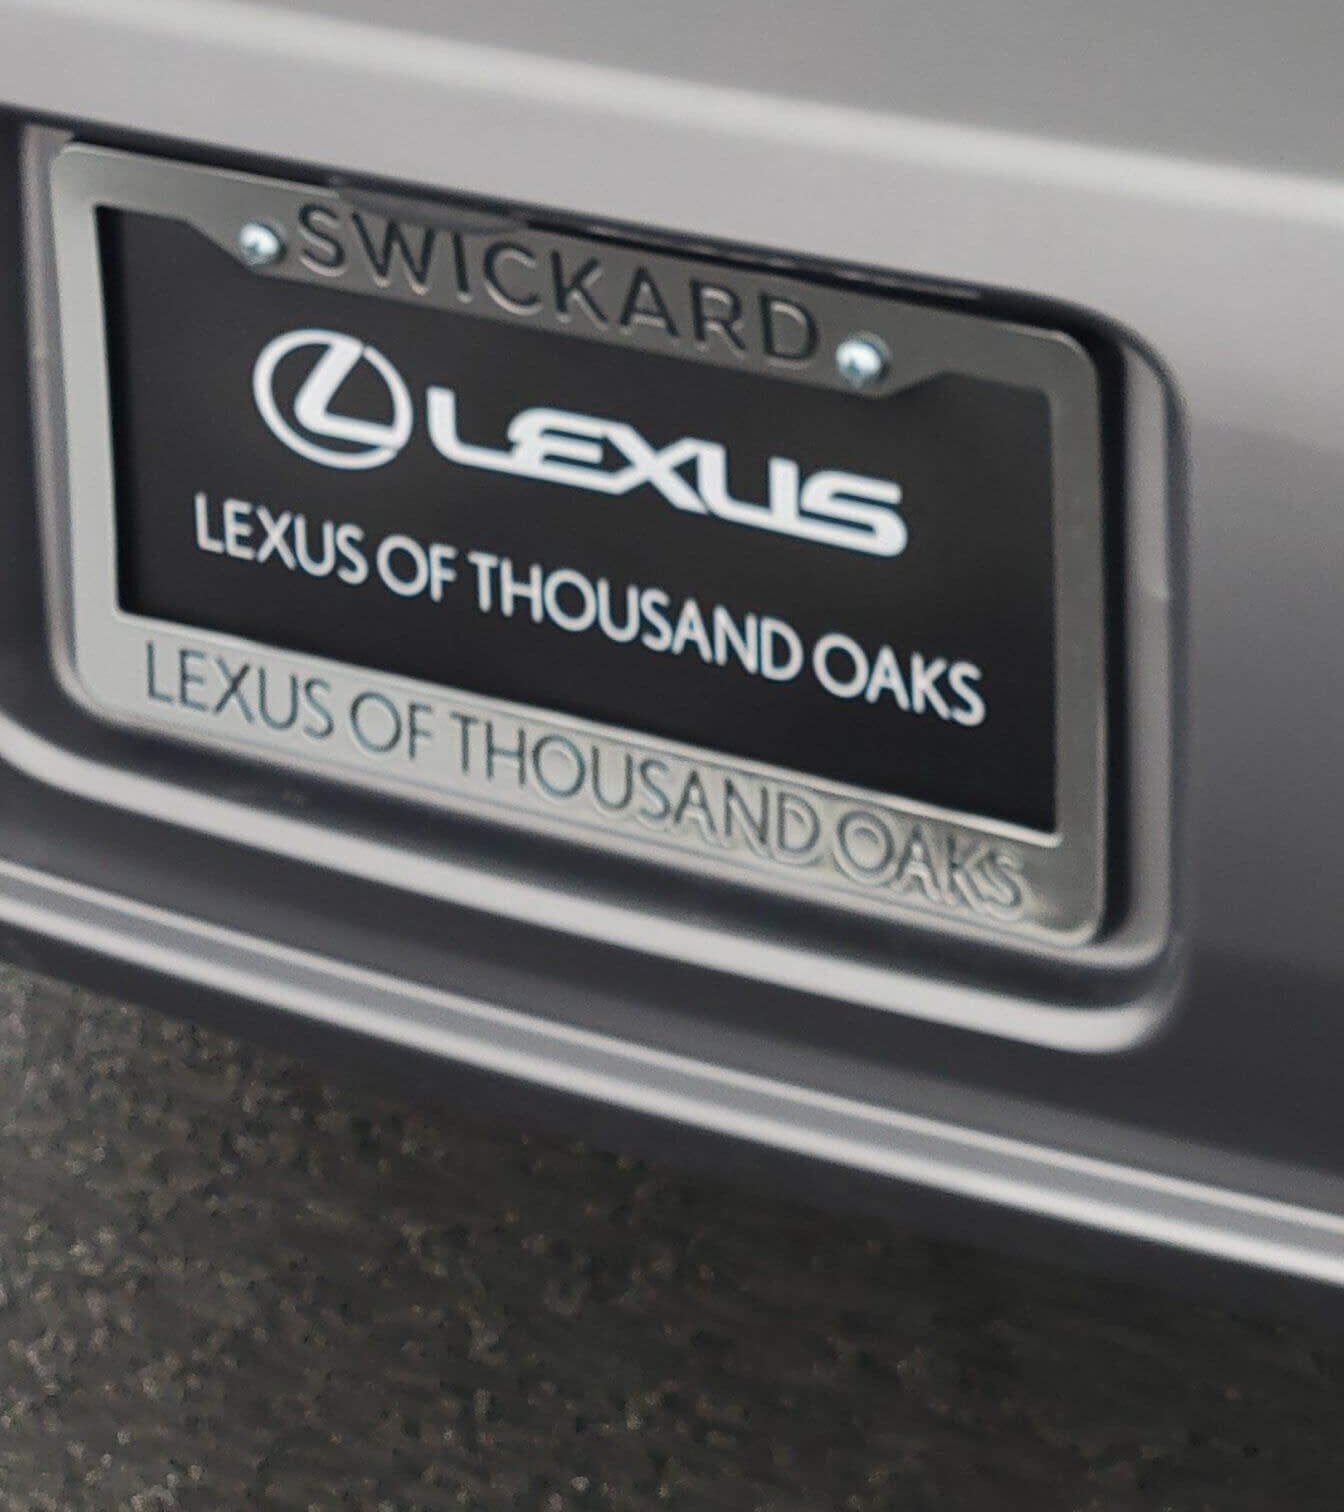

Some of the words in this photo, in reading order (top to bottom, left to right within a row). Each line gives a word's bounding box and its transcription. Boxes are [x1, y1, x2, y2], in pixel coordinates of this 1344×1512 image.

[297, 201, 820, 366] SWICKARD
[425, 384, 909, 558] LEXUS
[193, 491, 369, 586] LEXUS
[376, 533, 457, 603] OF
[467, 549, 805, 682] THOUSAND
[812, 632, 987, 727] OAKS
[145, 641, 334, 740] LEXUS
[350, 690, 434, 762] OF
[449, 709, 822, 867] THOUSAND
[833, 809, 1027, 922] OAKS
